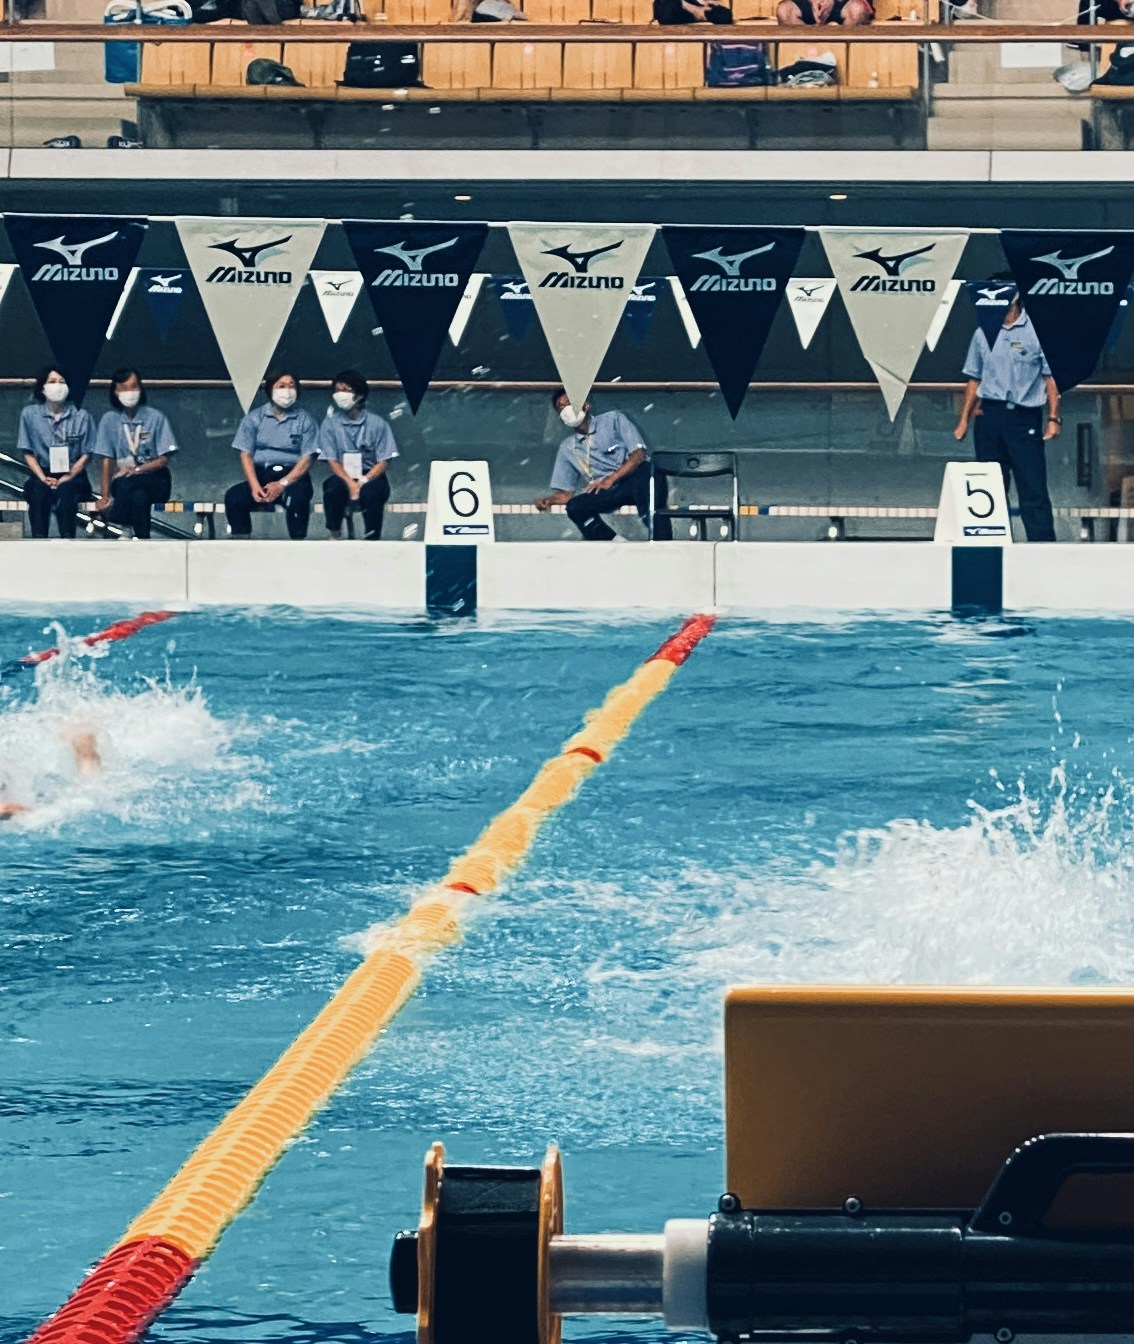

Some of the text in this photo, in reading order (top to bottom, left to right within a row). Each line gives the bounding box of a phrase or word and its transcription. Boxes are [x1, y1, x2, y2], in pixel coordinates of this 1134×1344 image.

[32, 264, 119, 281] MIZUNO
[206, 266, 292, 284] MIZUNO
[371, 269, 459, 287] MIZUNO
[538, 271, 624, 289] MIZUNO
[689, 274, 777, 292] MIZUNO
[850, 275, 936, 293] MIZUNO
[1027, 277, 1114, 295] MIZUNO
[448, 471, 480, 518] 6
[965, 473, 995, 519] 5
